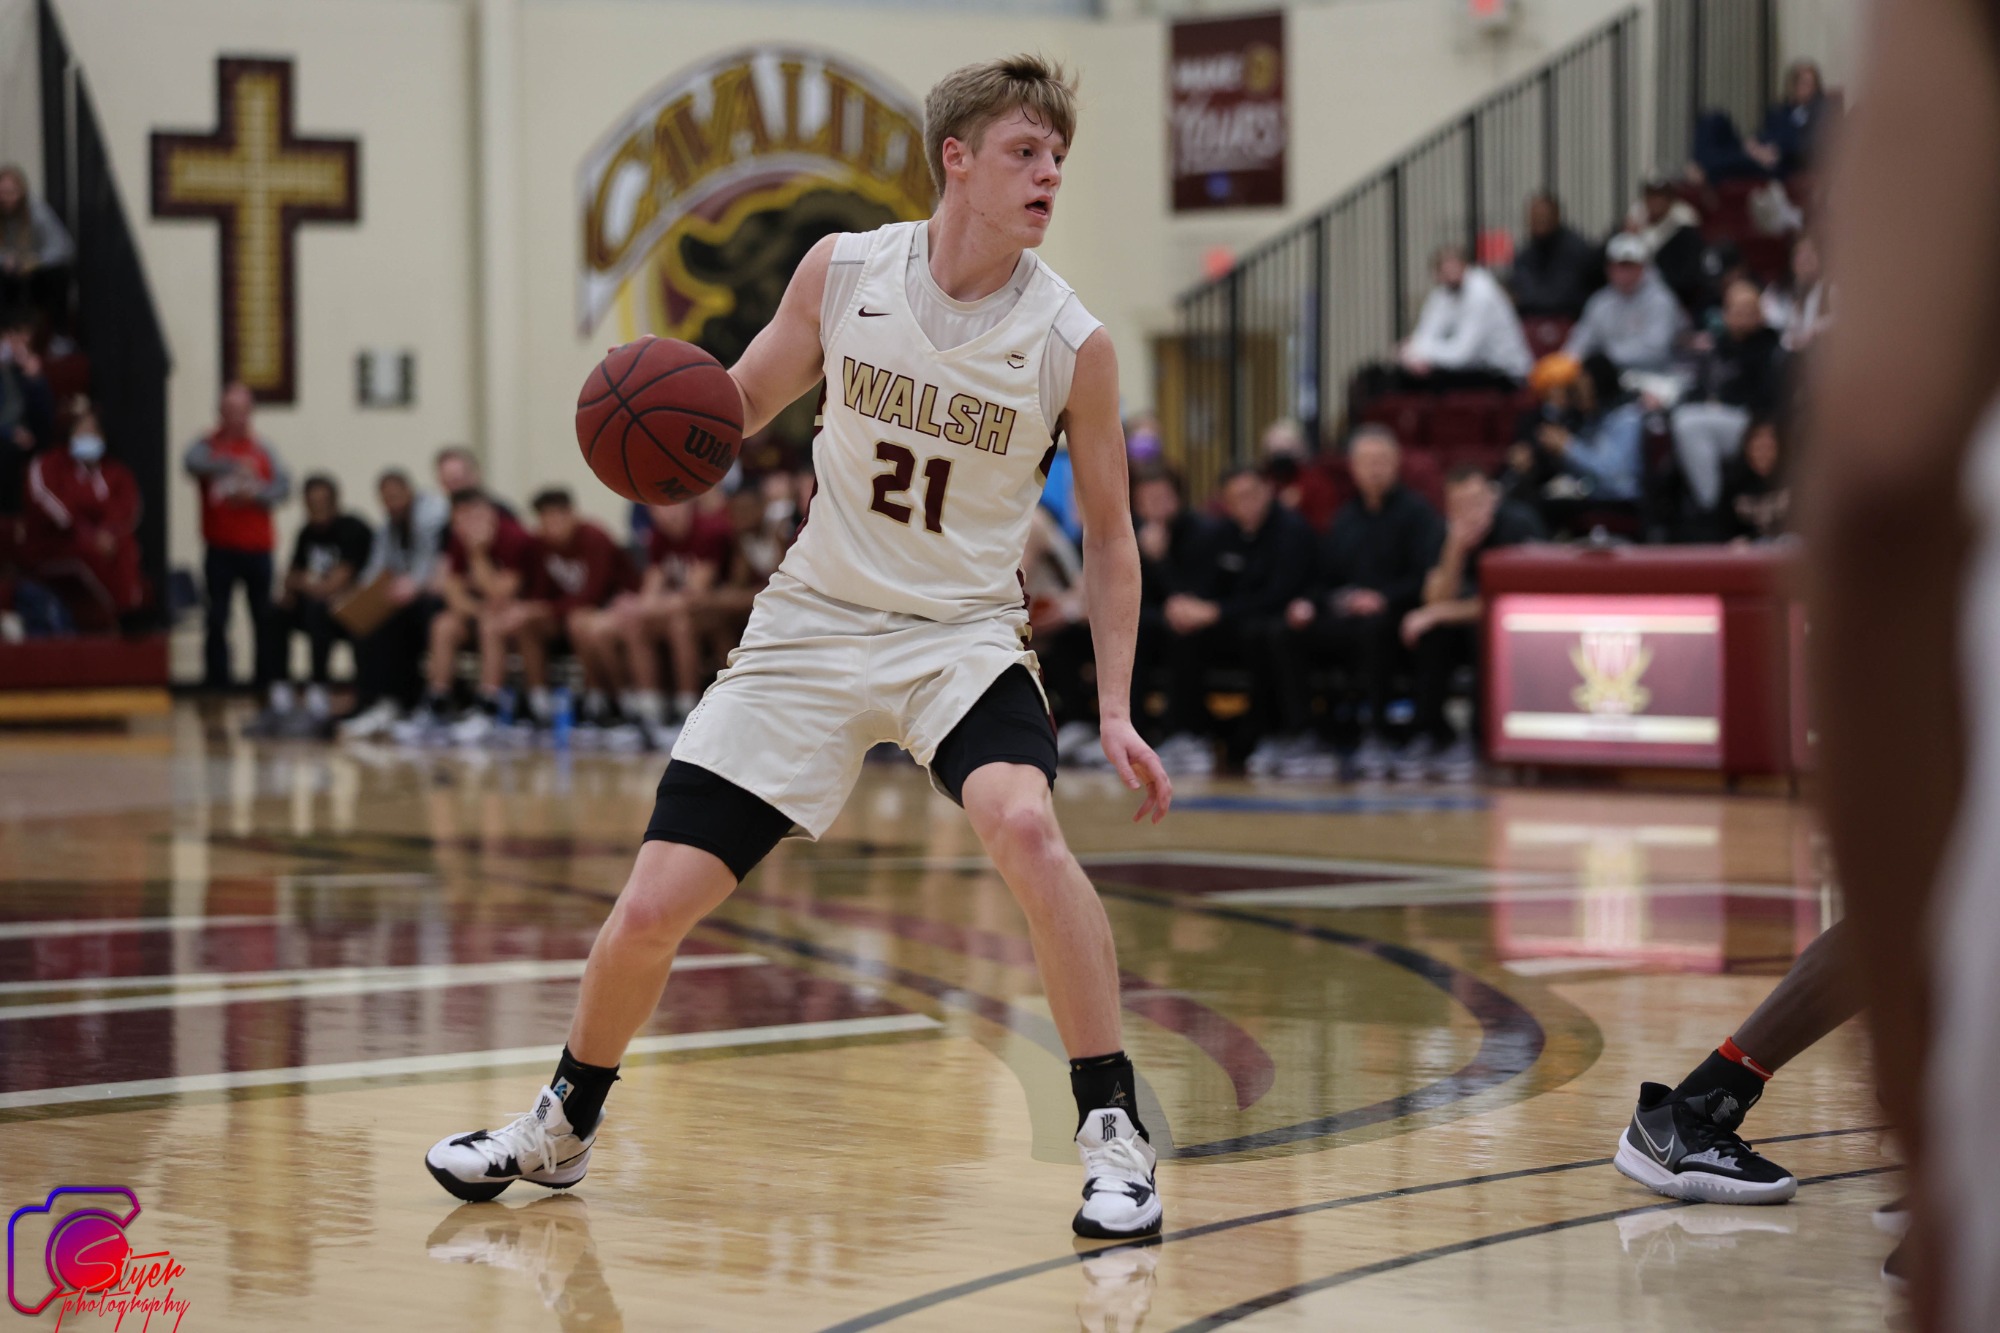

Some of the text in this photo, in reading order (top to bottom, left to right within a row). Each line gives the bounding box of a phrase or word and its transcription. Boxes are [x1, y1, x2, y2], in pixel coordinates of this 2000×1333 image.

[586, 54, 934, 272] CAVALIE
[842, 355, 1017, 456] WALSH
[867, 437, 956, 537] 21
